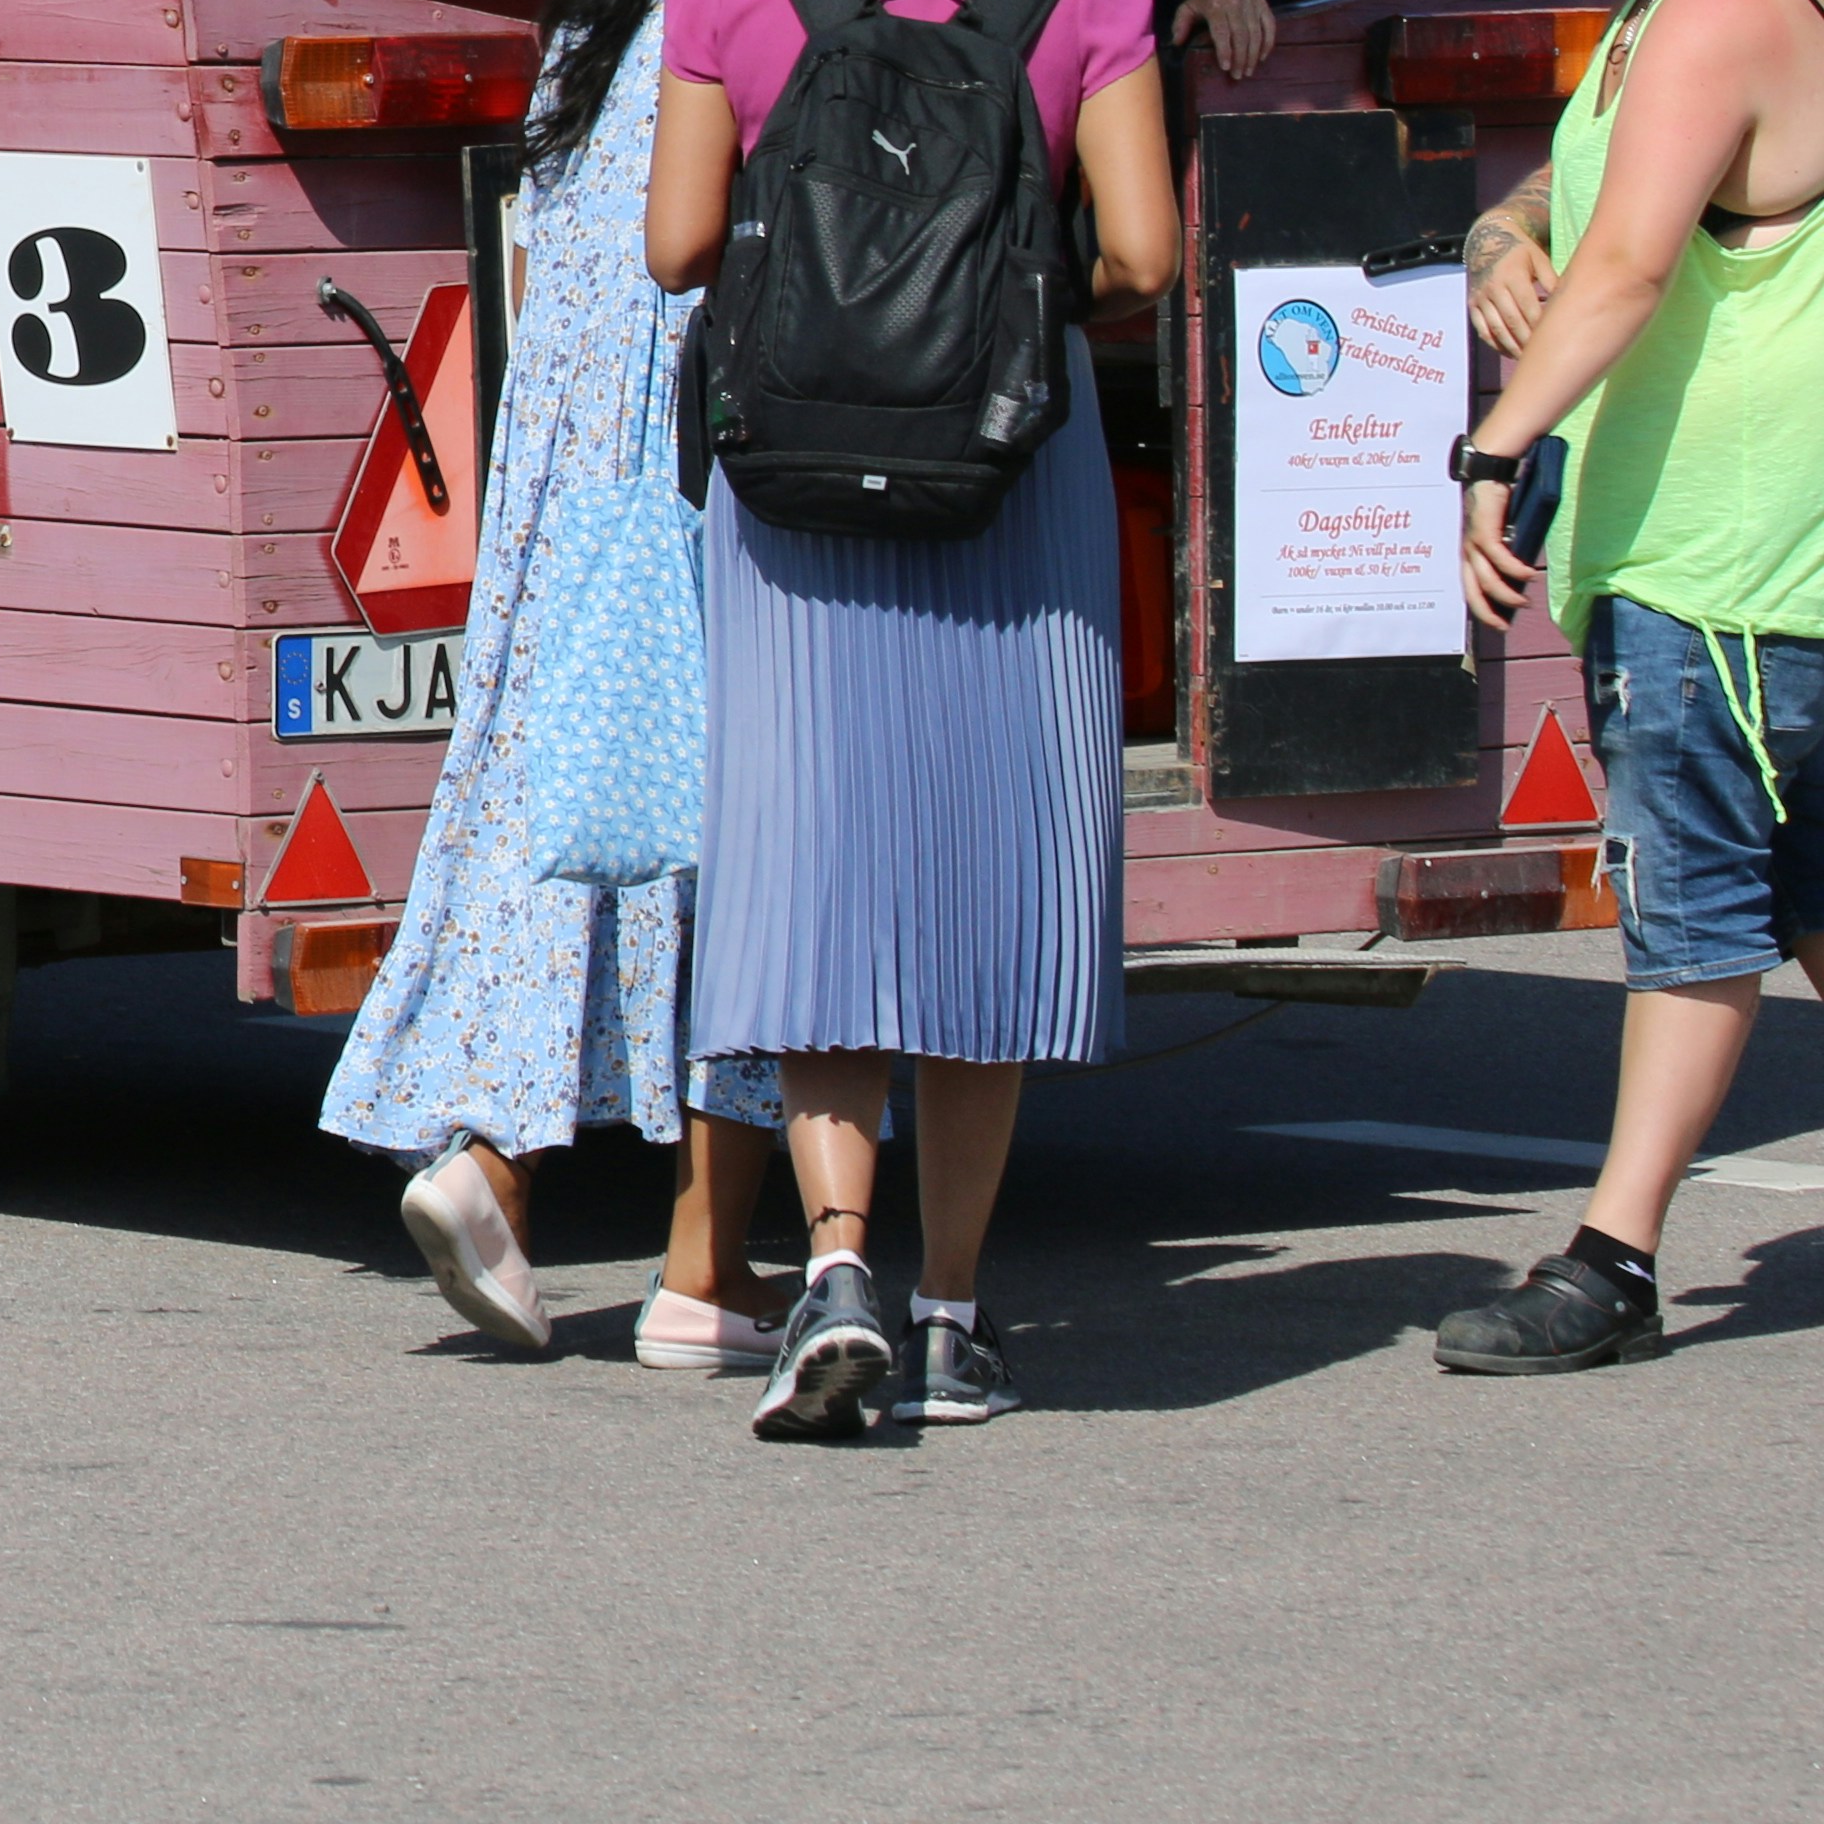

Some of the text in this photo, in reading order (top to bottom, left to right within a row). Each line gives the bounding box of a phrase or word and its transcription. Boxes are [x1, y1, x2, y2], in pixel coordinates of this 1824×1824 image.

[7, 226, 147, 387] 3
[1266, 304, 1334, 342] ALLT OM VEN
[1350, 307, 1445, 351] Prislista på
[1336, 336, 1447, 385] Traktorsläpen
[1308, 413, 1403, 445] Enkeltur
[1287, 453, 1318, 470] 40kr/
[1365, 451, 1396, 468] 20kr/
[1397, 450, 1421, 464] barn
[1298, 504, 1412, 540] Dagsbiljett
[1310, 543, 1347, 562] mycket
[1413, 541, 1433, 559] dag
[1400, 562, 1421, 574] barn
[287, 643, 457, 722] S KJA
